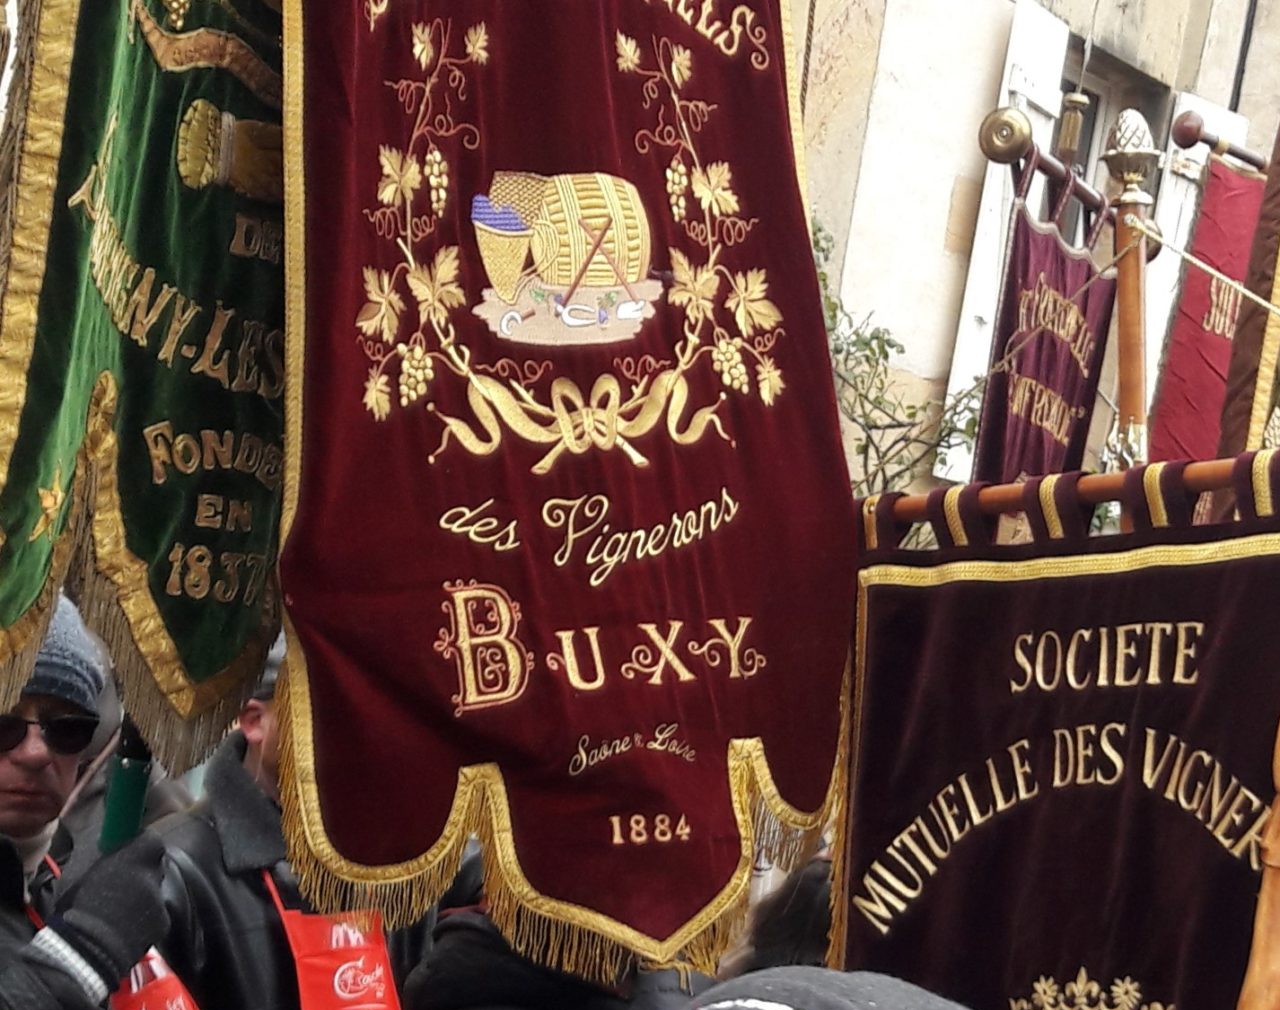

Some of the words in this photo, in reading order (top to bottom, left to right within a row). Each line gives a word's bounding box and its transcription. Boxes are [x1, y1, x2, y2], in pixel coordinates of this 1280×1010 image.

[195, 494, 251, 532] EN
[438, 499, 520, 551] des
[541, 487, 740, 587] Vignerons
[433, 578, 767, 718] BUXY
[1010, 621, 1205, 695] SOCIETE
[647, 723, 696, 762] Loire
[608, 814, 691, 845] 1884
[852, 738, 1040, 935] MUTUELLE
[1053, 721, 1127, 789] DES
[1142, 727, 1272, 871] VIGNER
